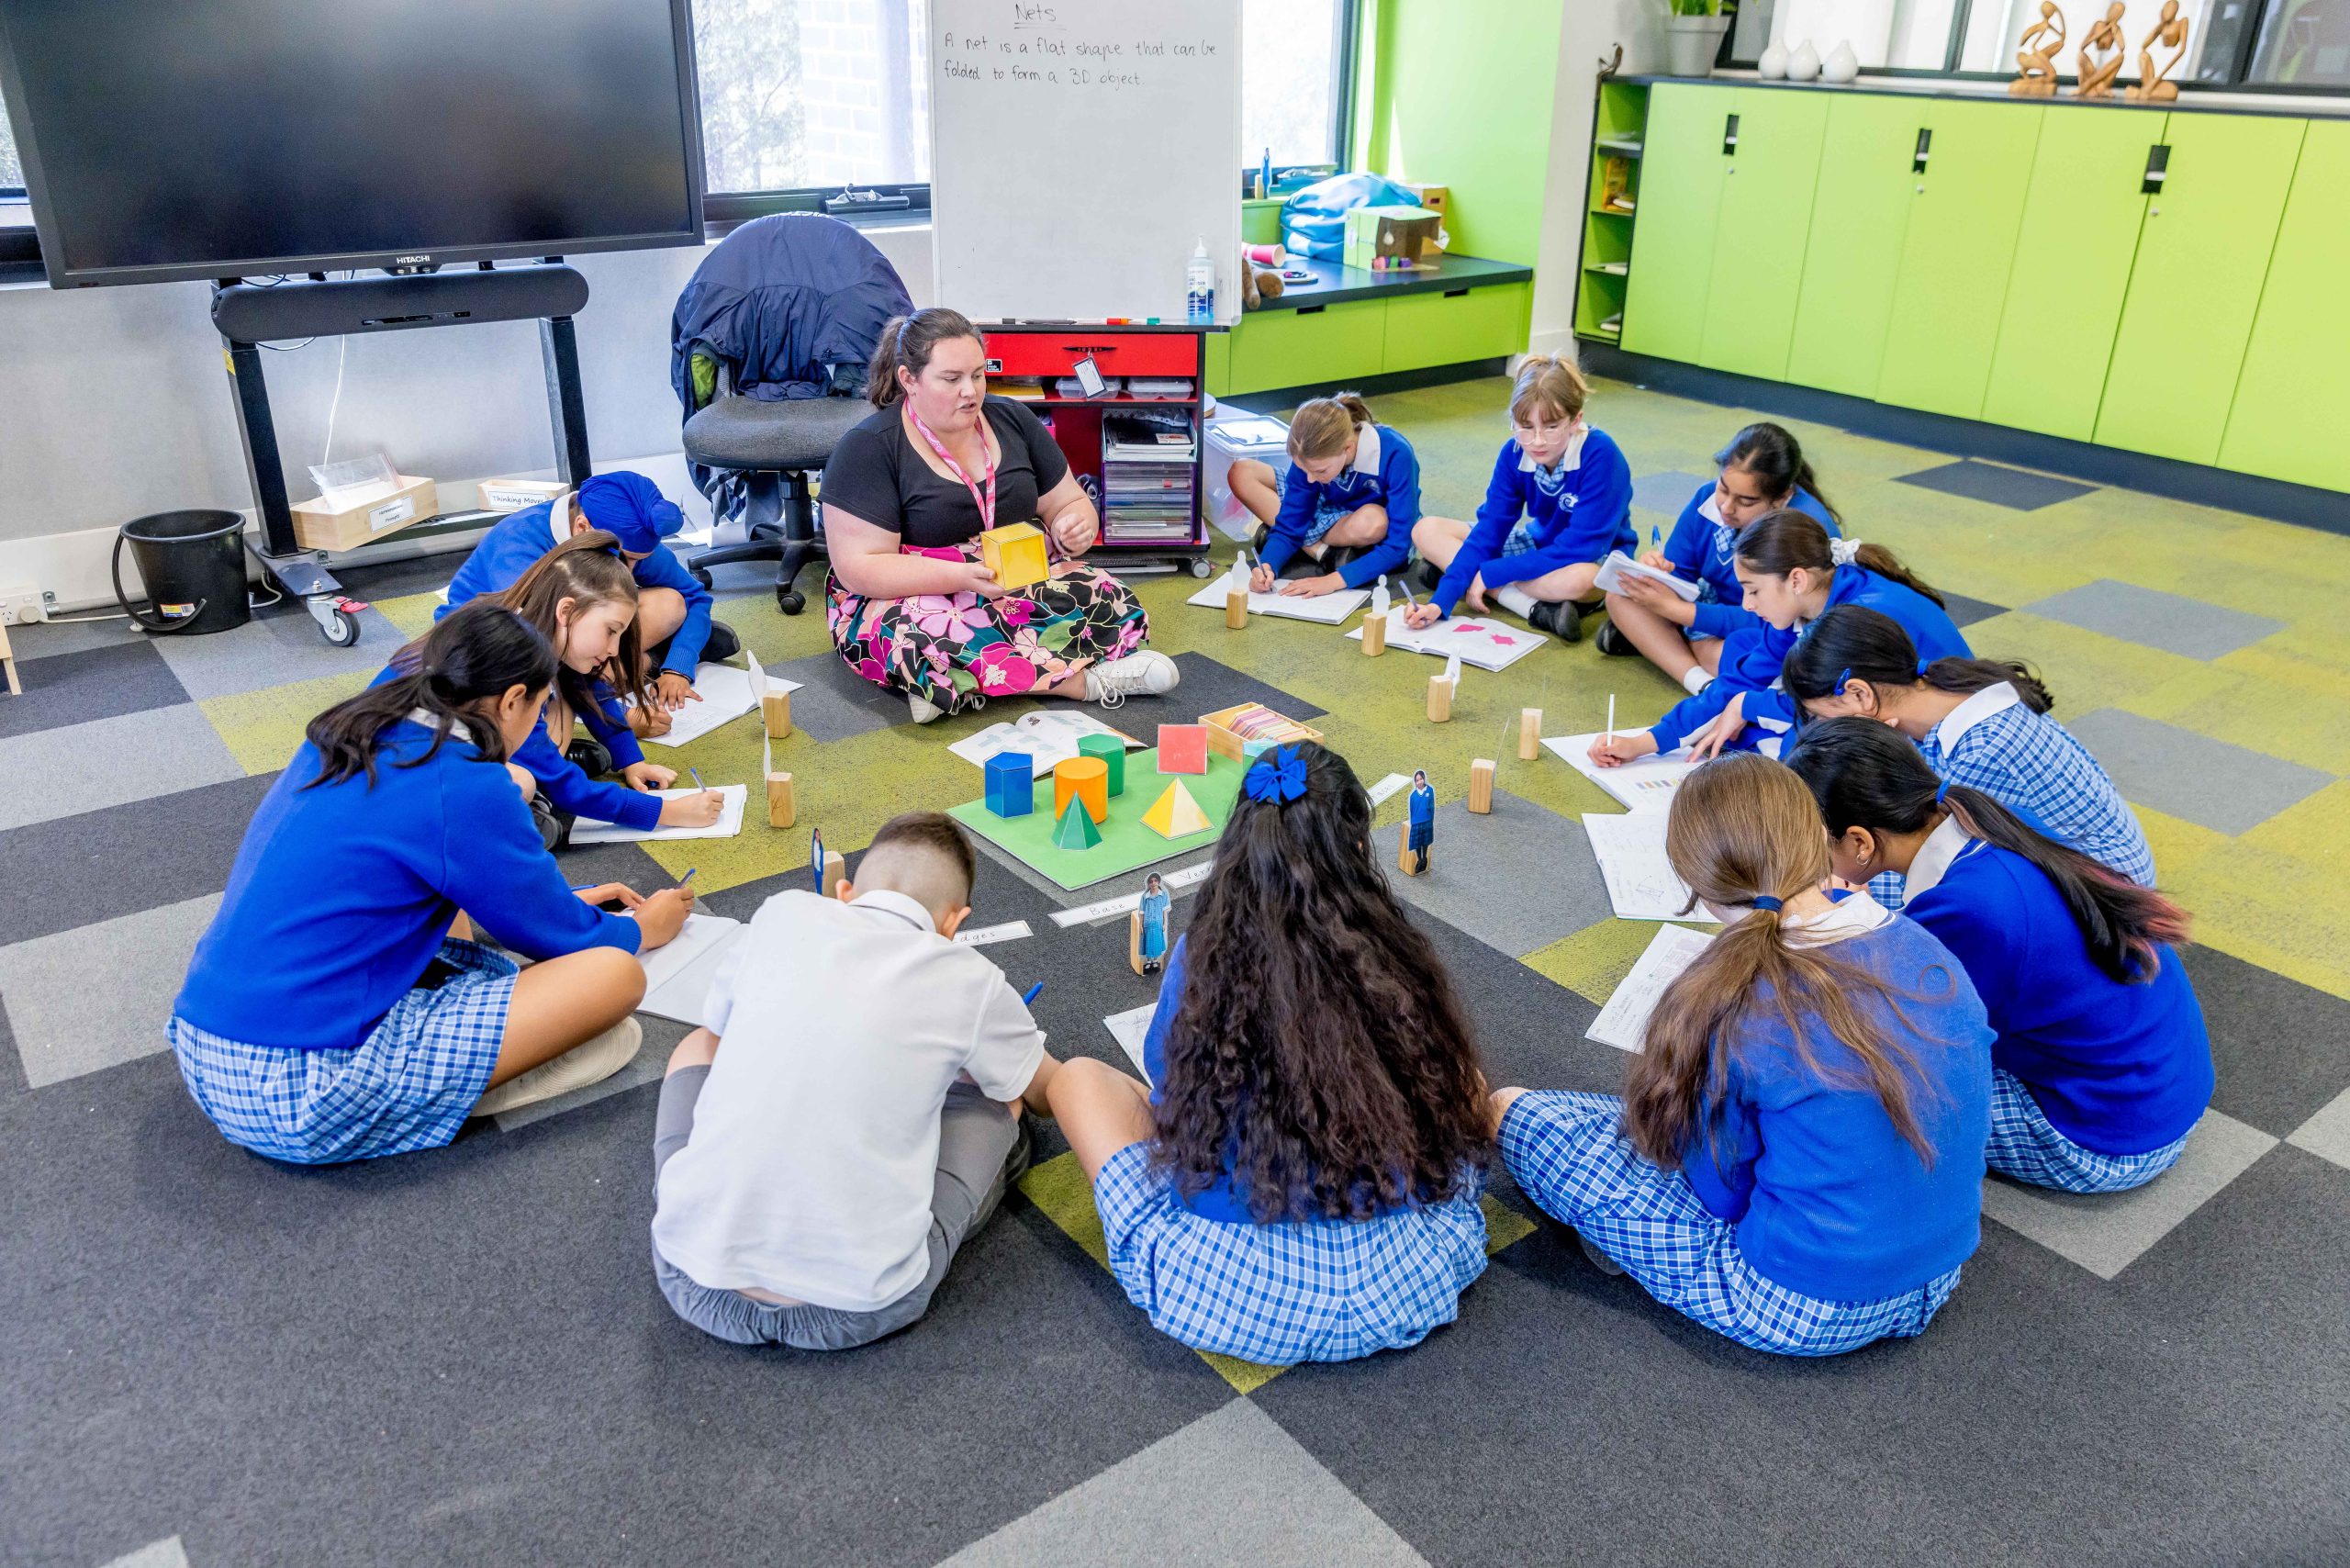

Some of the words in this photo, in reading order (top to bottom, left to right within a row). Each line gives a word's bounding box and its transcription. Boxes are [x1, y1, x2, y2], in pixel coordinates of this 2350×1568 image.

[1015, 3, 1057, 21] Nets
[945, 32, 954, 48] A
[966, 35, 988, 50] net
[1000, 40, 1011, 53] is
[1018, 43, 1028, 53] a
[1036, 38, 1066, 55] flat
[1076, 42, 1124, 62] shape
[1136, 40, 1166, 56] that
[1173, 45, 1196, 56] can
[1201, 39, 1217, 55] be
[945, 60, 981, 80] folded
[993, 68, 1004, 80] to
[1012, 65, 1041, 82] form
[1047, 73, 1058, 84] a
[1069, 68, 1091, 85] 3D
[397, 255, 431, 264] HITACHI
[493, 496, 521, 506] Thinking
[1090, 904, 1125, 915] Base
[960, 932, 995, 943] dges
